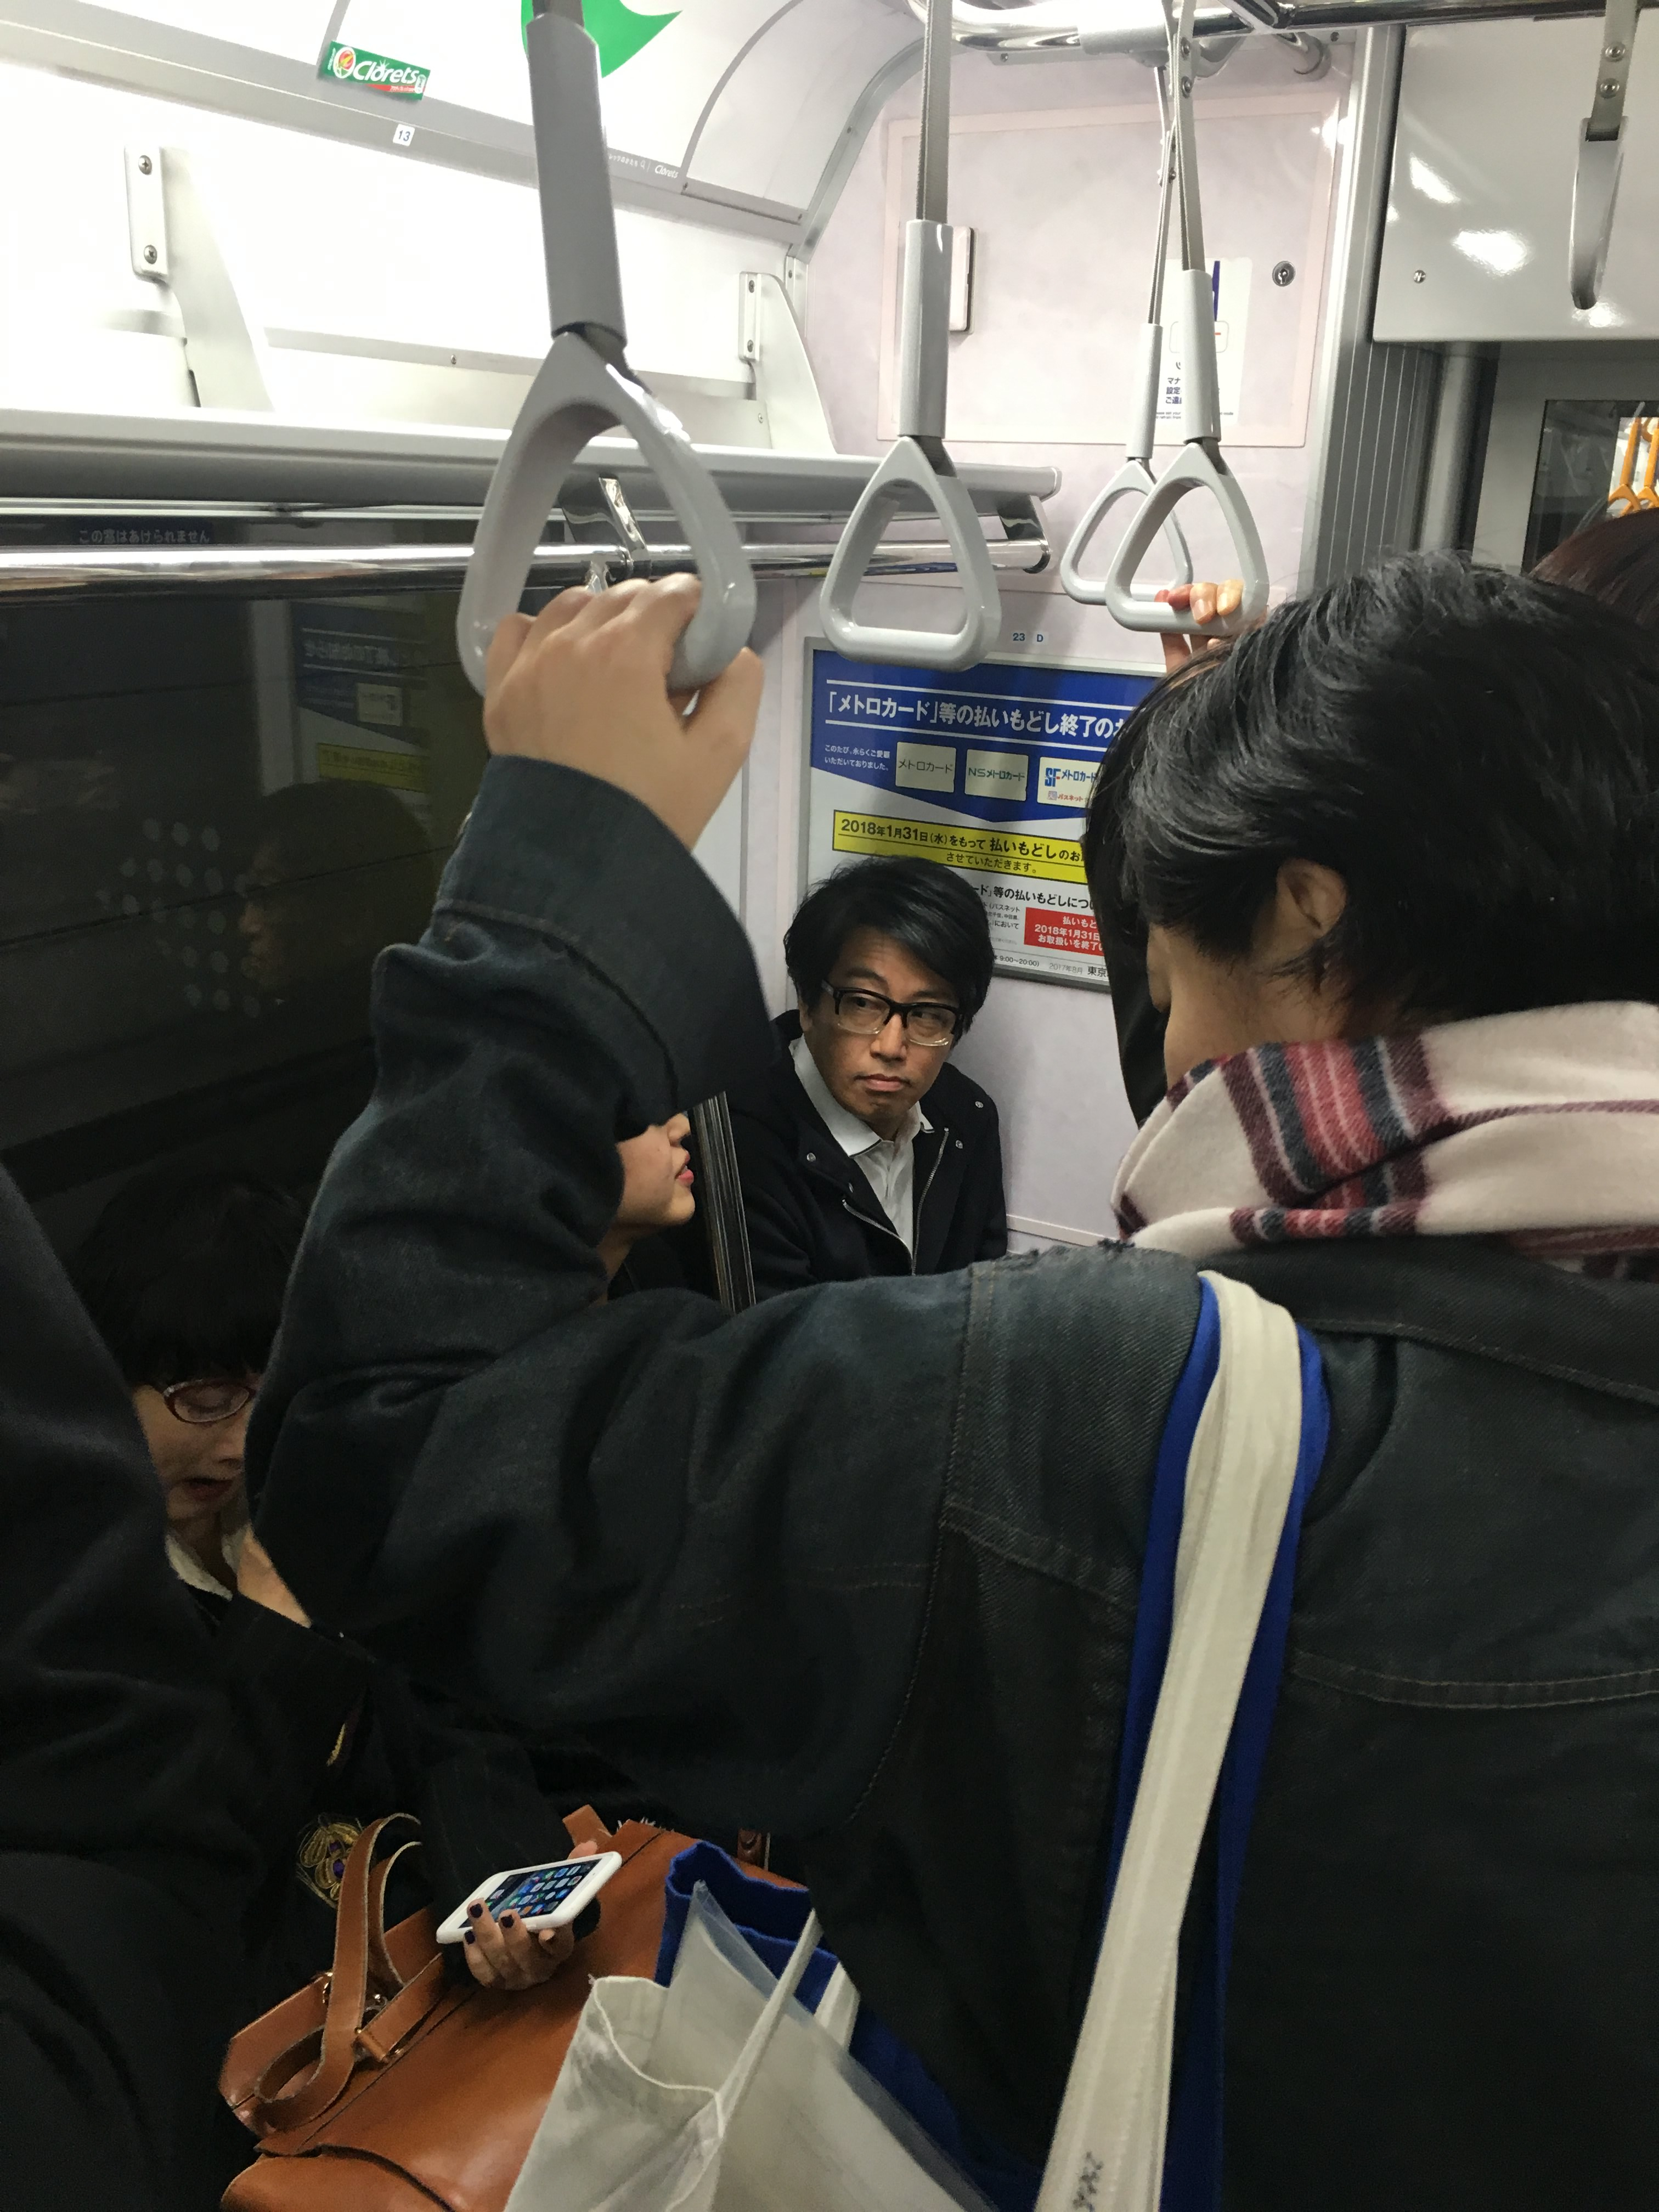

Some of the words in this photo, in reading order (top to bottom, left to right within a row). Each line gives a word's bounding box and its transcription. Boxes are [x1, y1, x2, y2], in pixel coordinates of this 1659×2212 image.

[353, 60, 420, 84] Clorets
[398, 129, 411, 142] 13
[654, 165, 679, 178] Clorets
[1166, 386, 1182, 395] 設定
[1165, 396, 1182, 404] ご遠
[1012, 633, 1025, 641] 23
[1036, 634, 1044, 642] D
[899, 759, 953, 774] メトロカード
[946, 851, 1037, 873] させていただきます。
[1087, 966, 1108, 978] 東京
